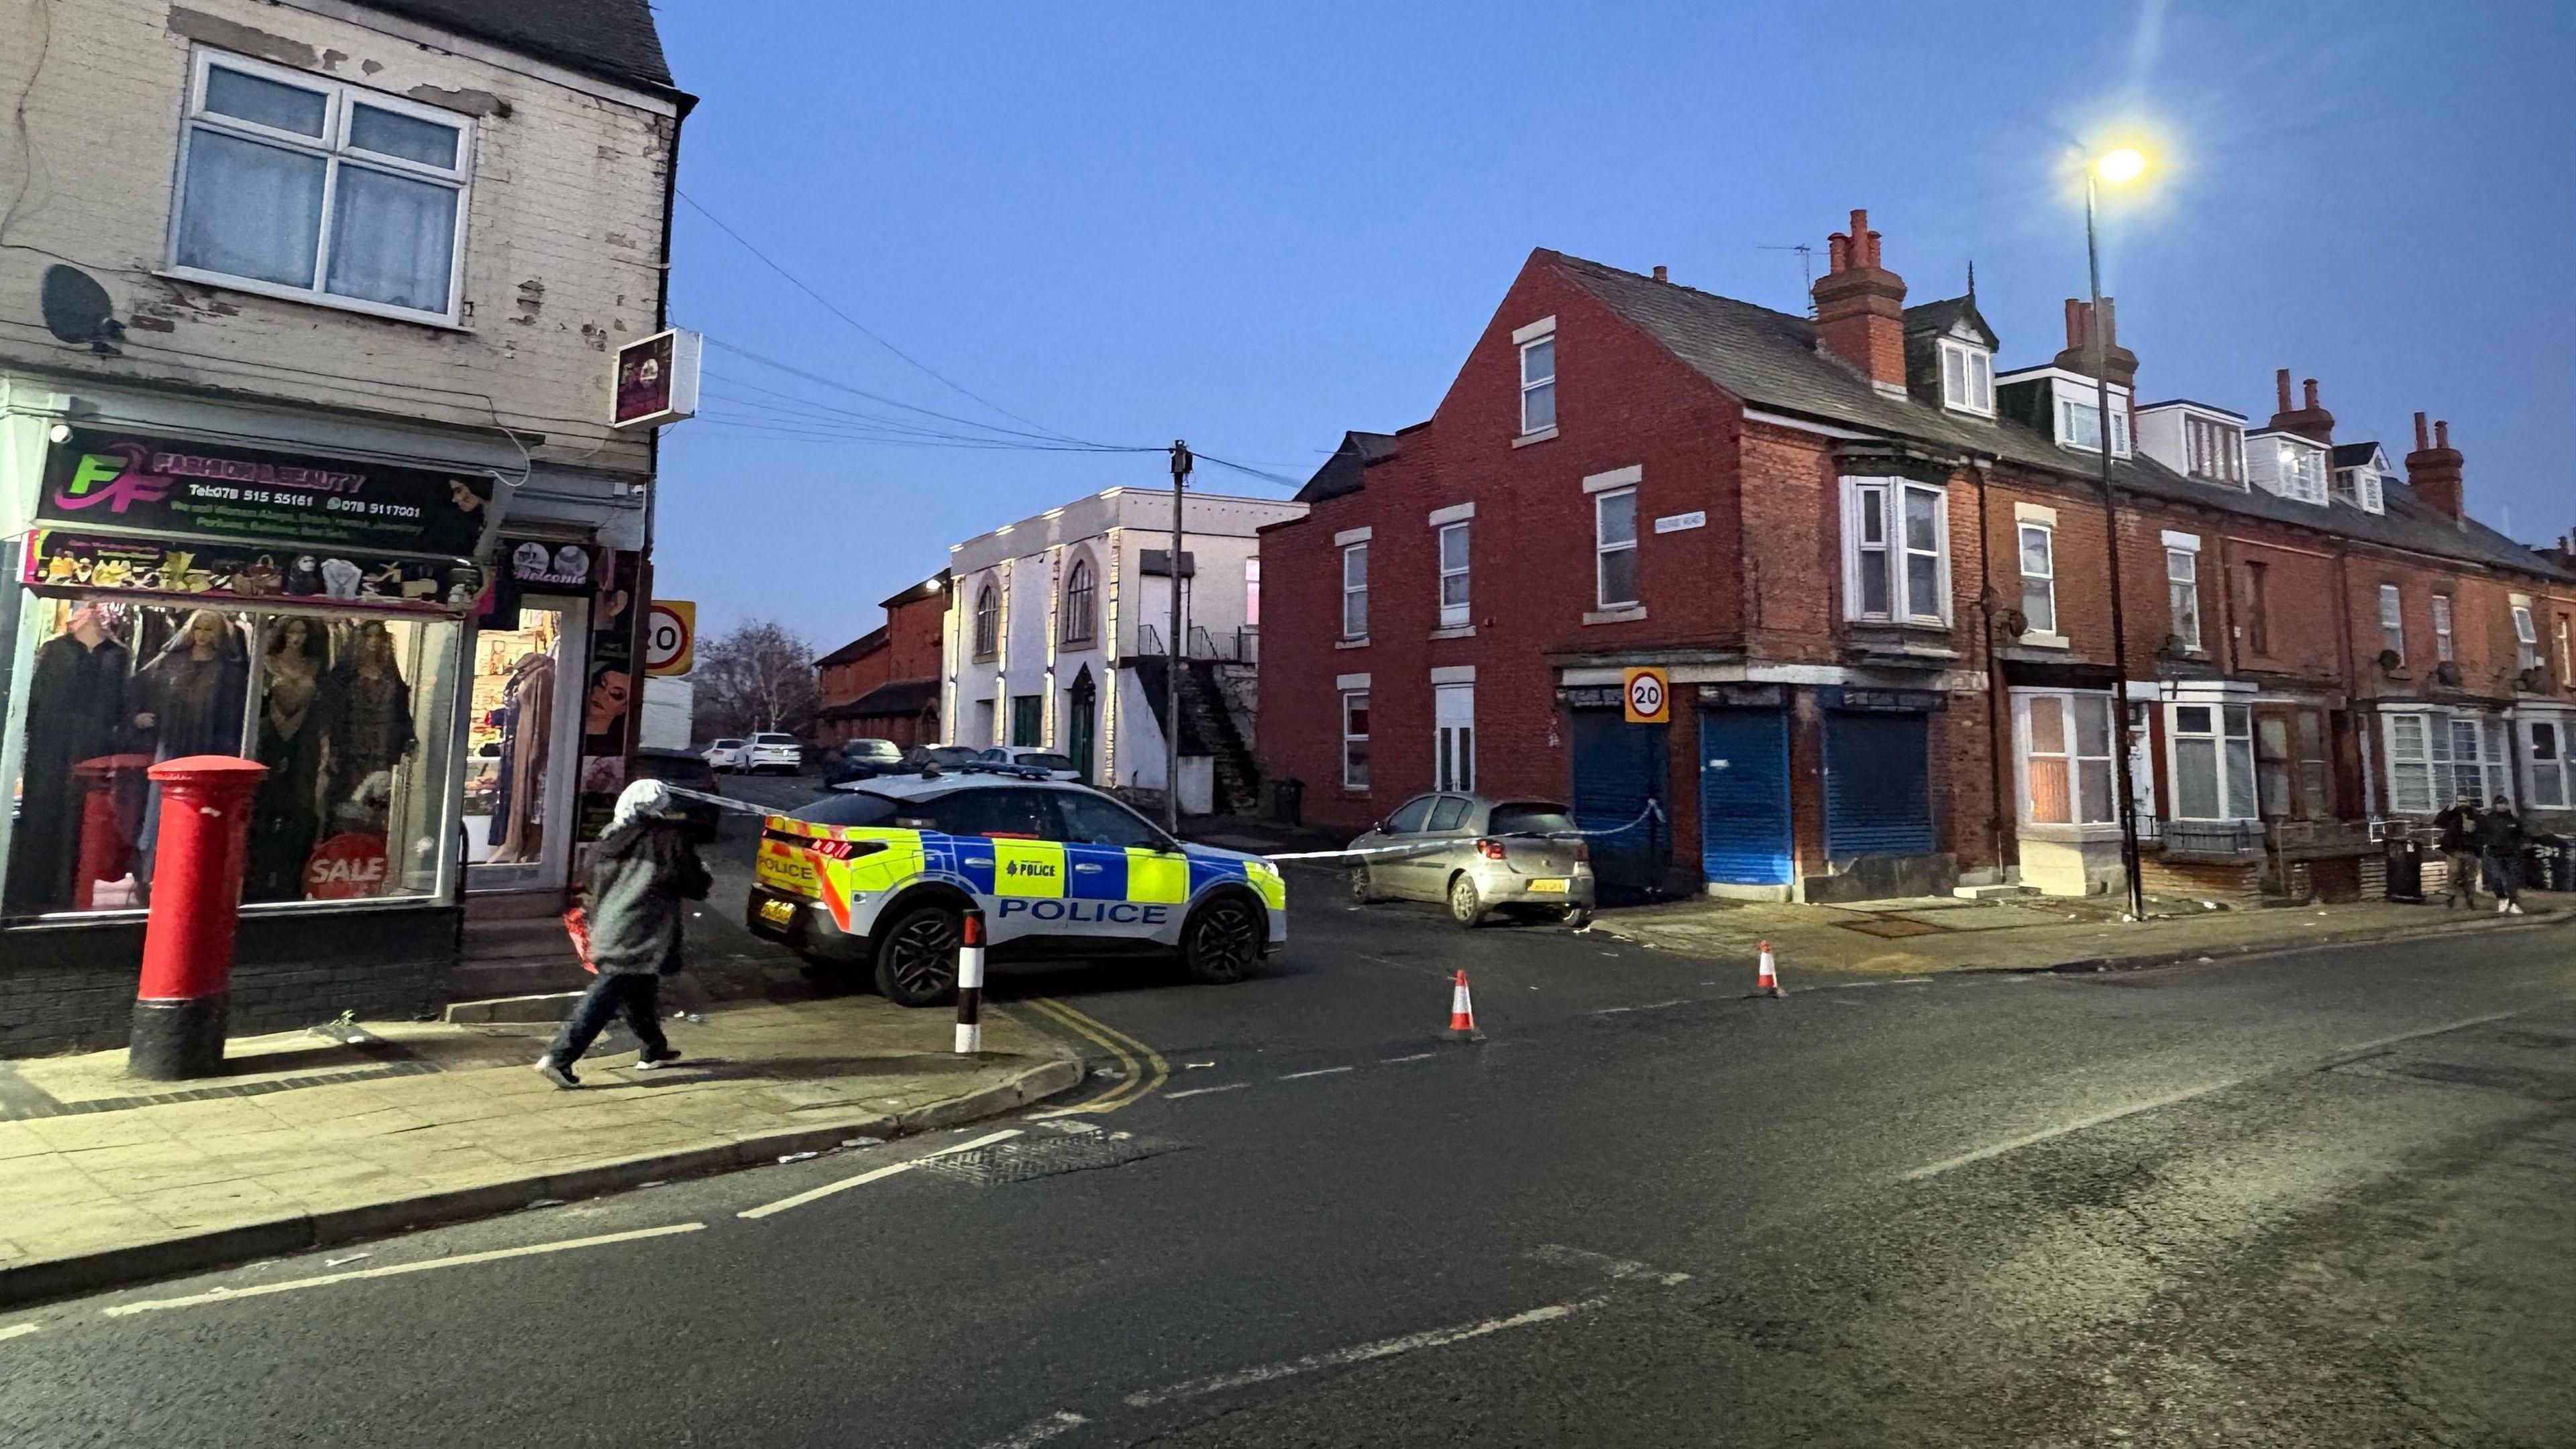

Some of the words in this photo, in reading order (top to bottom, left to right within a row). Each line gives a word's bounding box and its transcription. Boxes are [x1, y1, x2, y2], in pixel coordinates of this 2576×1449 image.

[243, 490, 270, 502] 515
[1635, 686, 1658, 704] 20
[309, 858, 384, 883] SALE
[1020, 863, 1055, 877] POLICE
[998, 899, 1168, 924] POLICE
